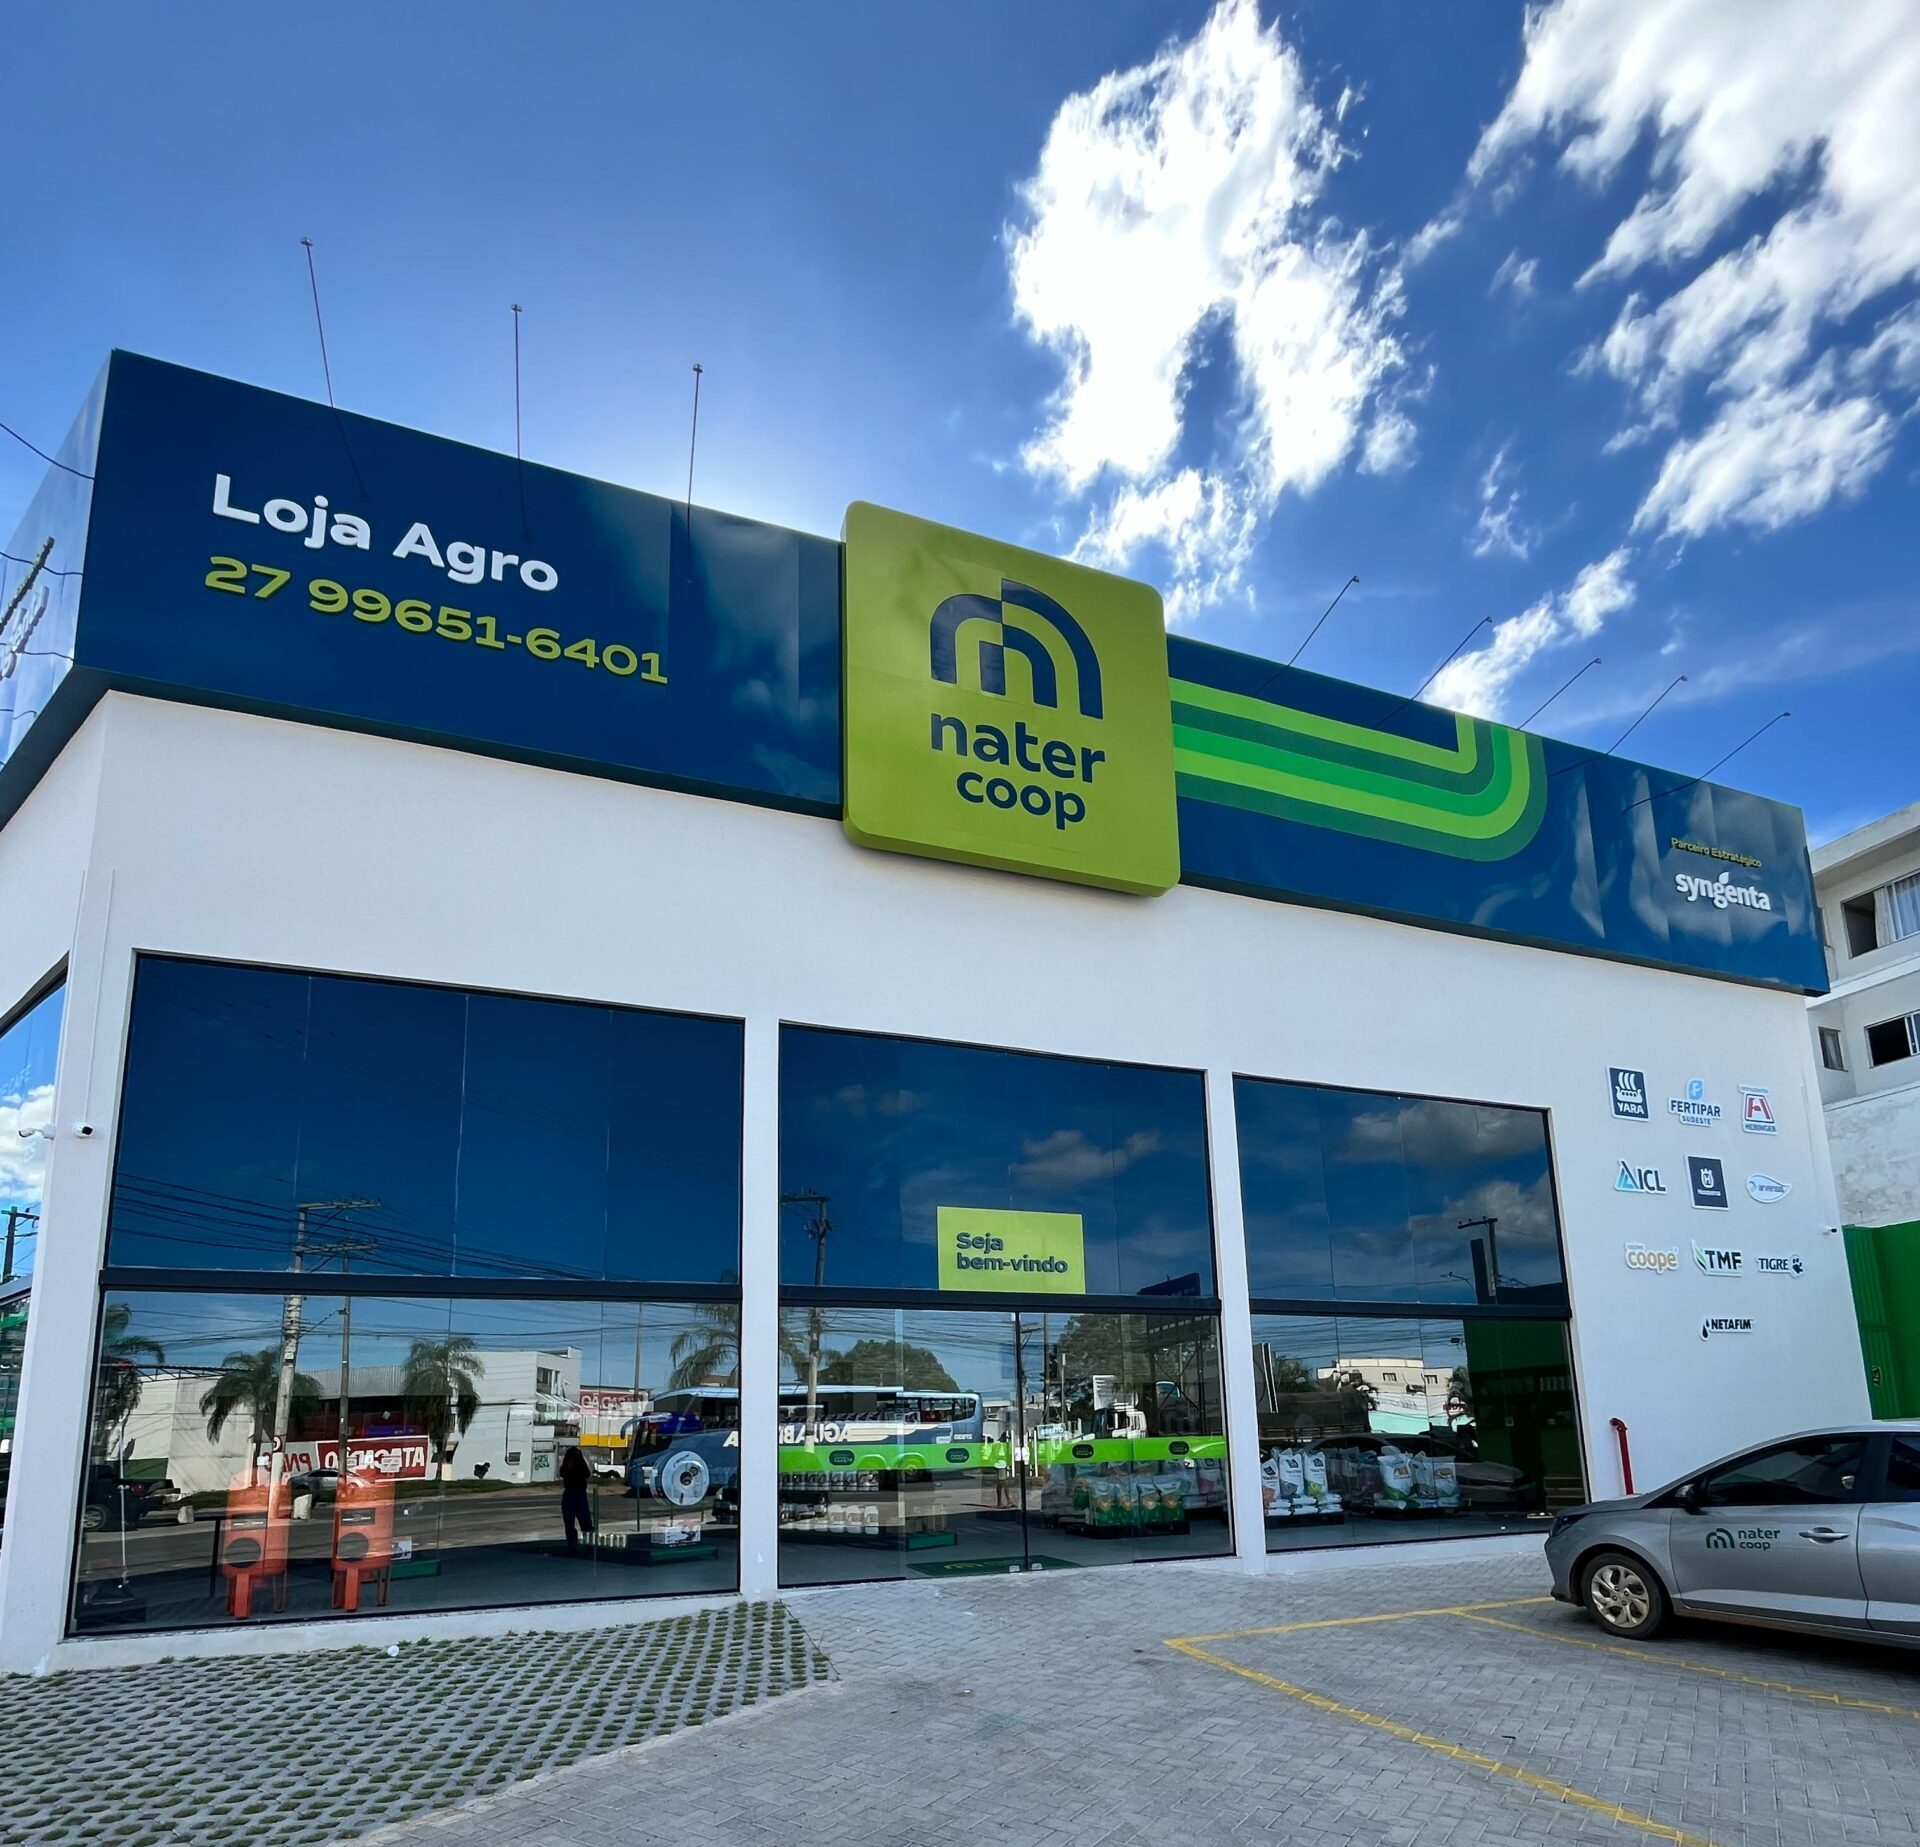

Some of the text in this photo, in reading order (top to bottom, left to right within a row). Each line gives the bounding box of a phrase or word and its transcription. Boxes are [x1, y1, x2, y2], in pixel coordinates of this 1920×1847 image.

[212, 473, 559, 592] Loja Agro
[205, 556, 668, 685] 27 99651-6401
[931, 712, 1106, 783] nater
[956, 771, 1086, 831] coop
[1671, 837, 1710, 855] Parceiro
[1675, 873, 1771, 910] syngenta
[1617, 1102, 1645, 1115] YARA
[1671, 1100, 1721, 1117] FERTIPAR
[1682, 1115, 1712, 1126] SUDESTE
[1637, 1168, 1666, 1192] ICL
[956, 1232, 1004, 1254] Seja
[956, 1252, 1069, 1273] bem-vindo
[1628, 1251, 1677, 1271] coope
[1705, 1250, 1742, 1270] TMF
[1758, 1258, 1789, 1270] TIGRE
[1711, 1318, 1751, 1330] NETAFIM
[1738, 1528, 1781, 1539] nater
[1739, 1541, 1771, 1552] coop
